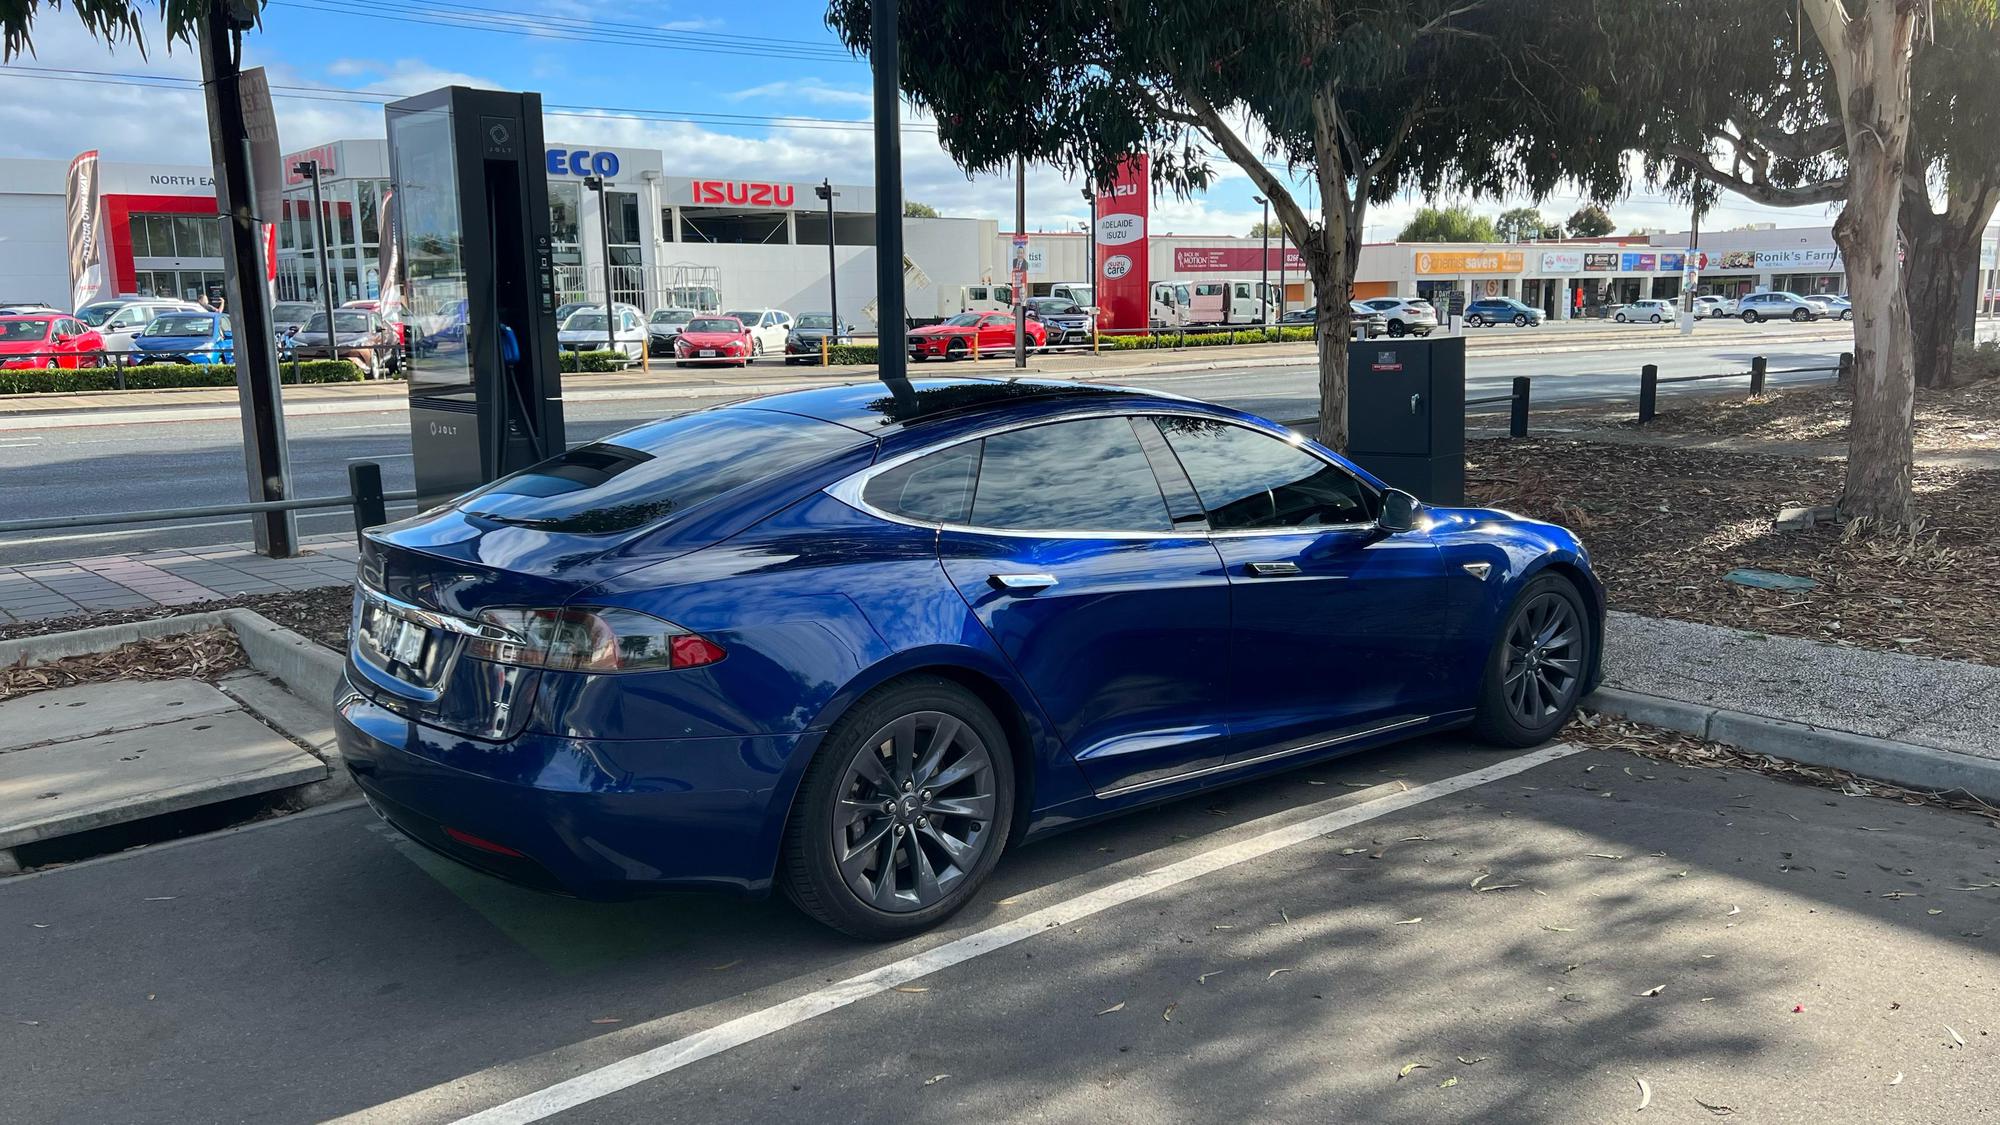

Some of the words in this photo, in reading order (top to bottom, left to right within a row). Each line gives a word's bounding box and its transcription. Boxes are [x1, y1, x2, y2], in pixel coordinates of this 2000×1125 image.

[546, 149, 620, 178] ECO
[150, 175, 195, 186] NORTH
[692, 181, 795, 207] ISUZU
[1102, 219, 1133, 229] ADELAIDE
[1106, 231, 1127, 239] ISUZU
[1756, 251, 1801, 262] Ronik's
[1465, 256, 1498, 269] savers
[1107, 266, 1125, 275] care
[438, 425, 457, 435] JOLT
